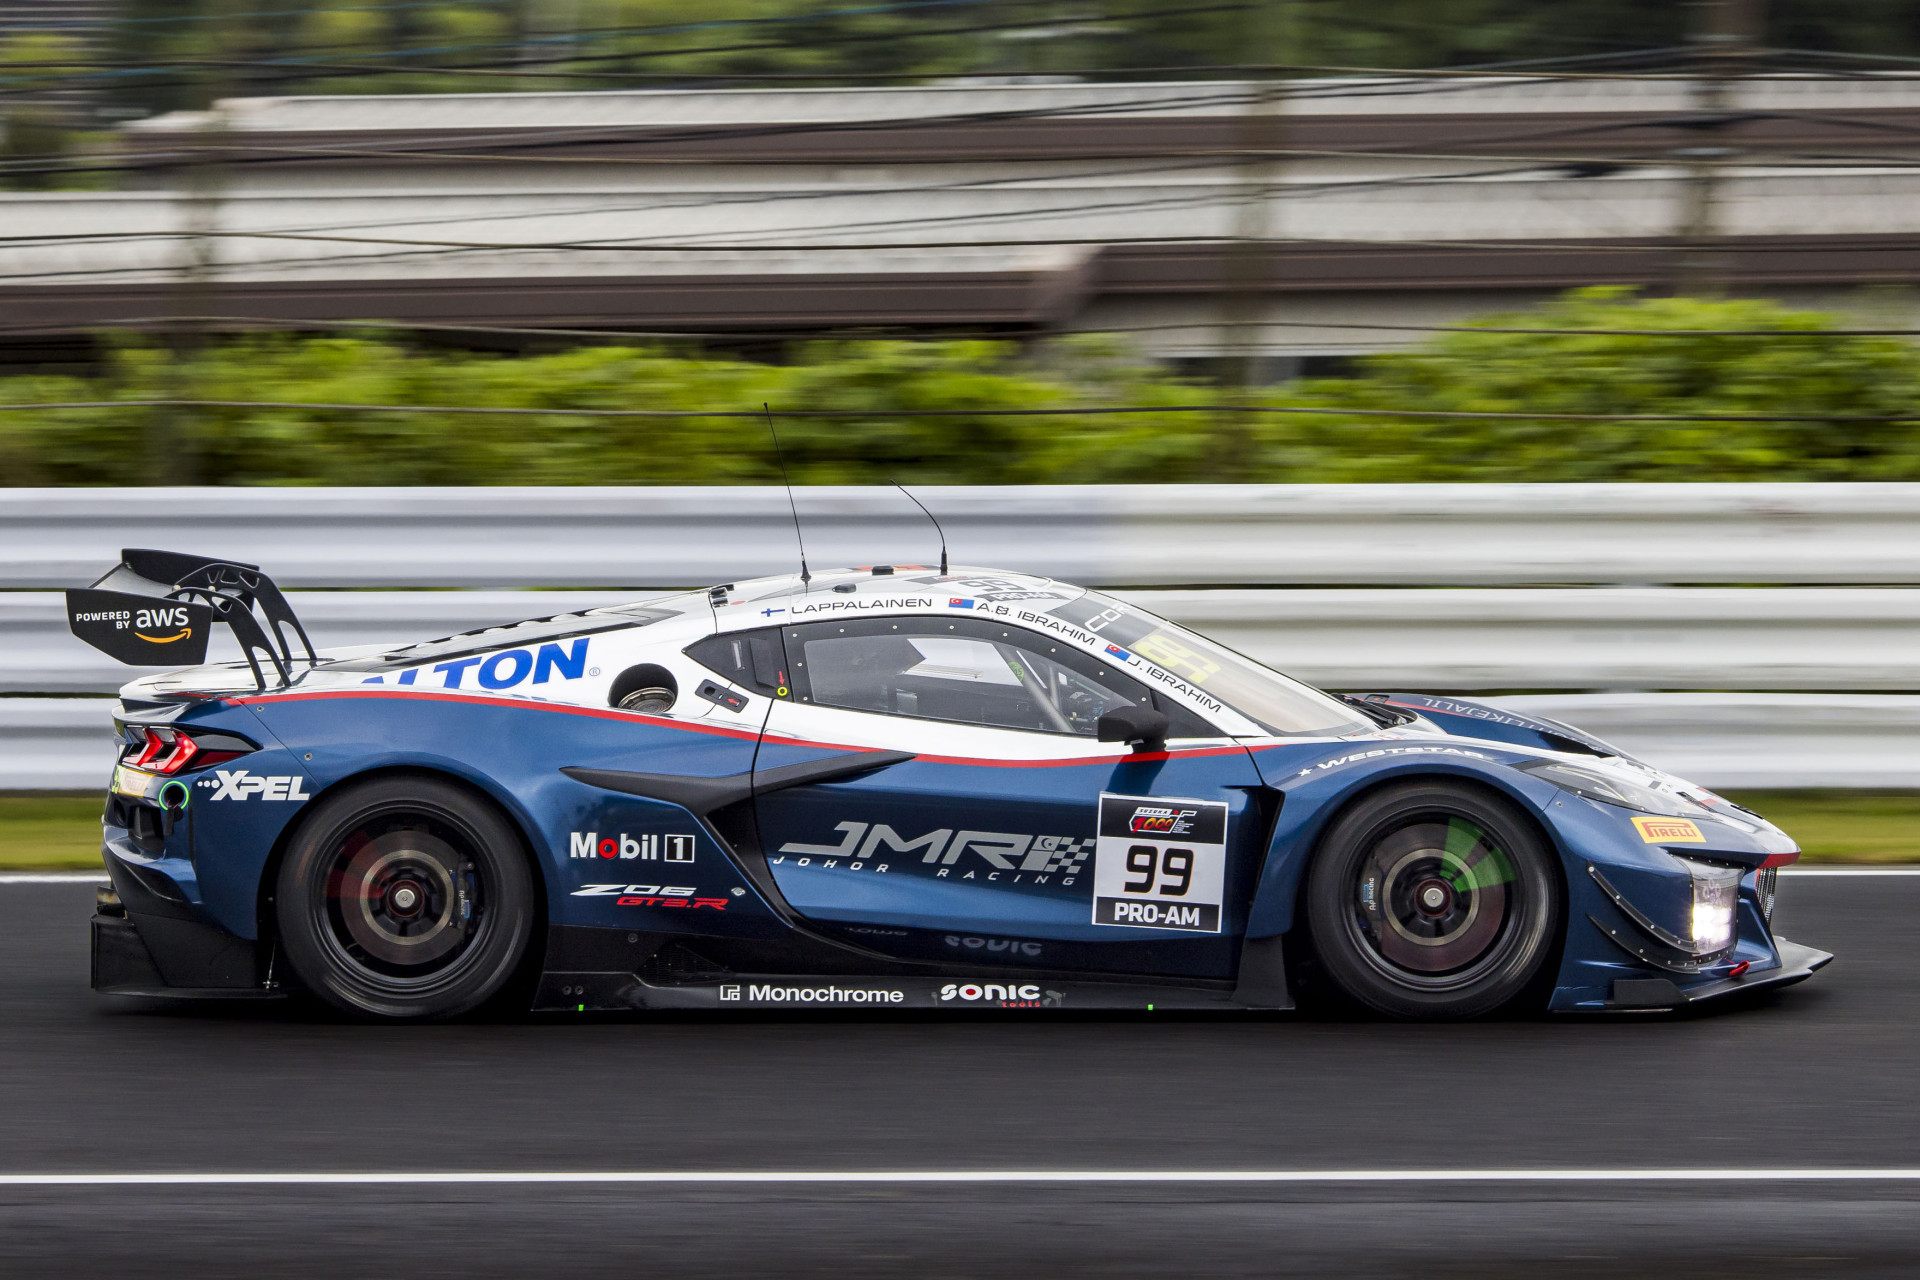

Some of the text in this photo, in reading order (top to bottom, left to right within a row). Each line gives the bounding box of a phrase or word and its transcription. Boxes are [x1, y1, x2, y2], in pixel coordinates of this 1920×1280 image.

[75, 610, 131, 622] POWERED
[791, 598, 932, 614] LAPPALAINEN
[116, 620, 131, 630] BY
[135, 607, 189, 629] aws
[976, 602, 1096, 646] A.B. IBRAHIM
[1127, 659, 1222, 713] J. IBRAHIM
[1316, 747, 1485, 770] WESTSTAR
[209, 769, 311, 801] XPEL
[1130, 816, 1174, 833] 1000
[1641, 821, 1698, 838] PIRELLI
[570, 831, 658, 860] Mobil
[777, 820, 1034, 870] JMR
[772, 856, 1076, 886] JOHOR RACING
[1124, 844, 1195, 897] 99
[569, 884, 697, 897] Z06
[616, 896, 729, 910] GT3.R
[1114, 901, 1200, 927] PRO-AM
[749, 984, 904, 1002] Monochrome
